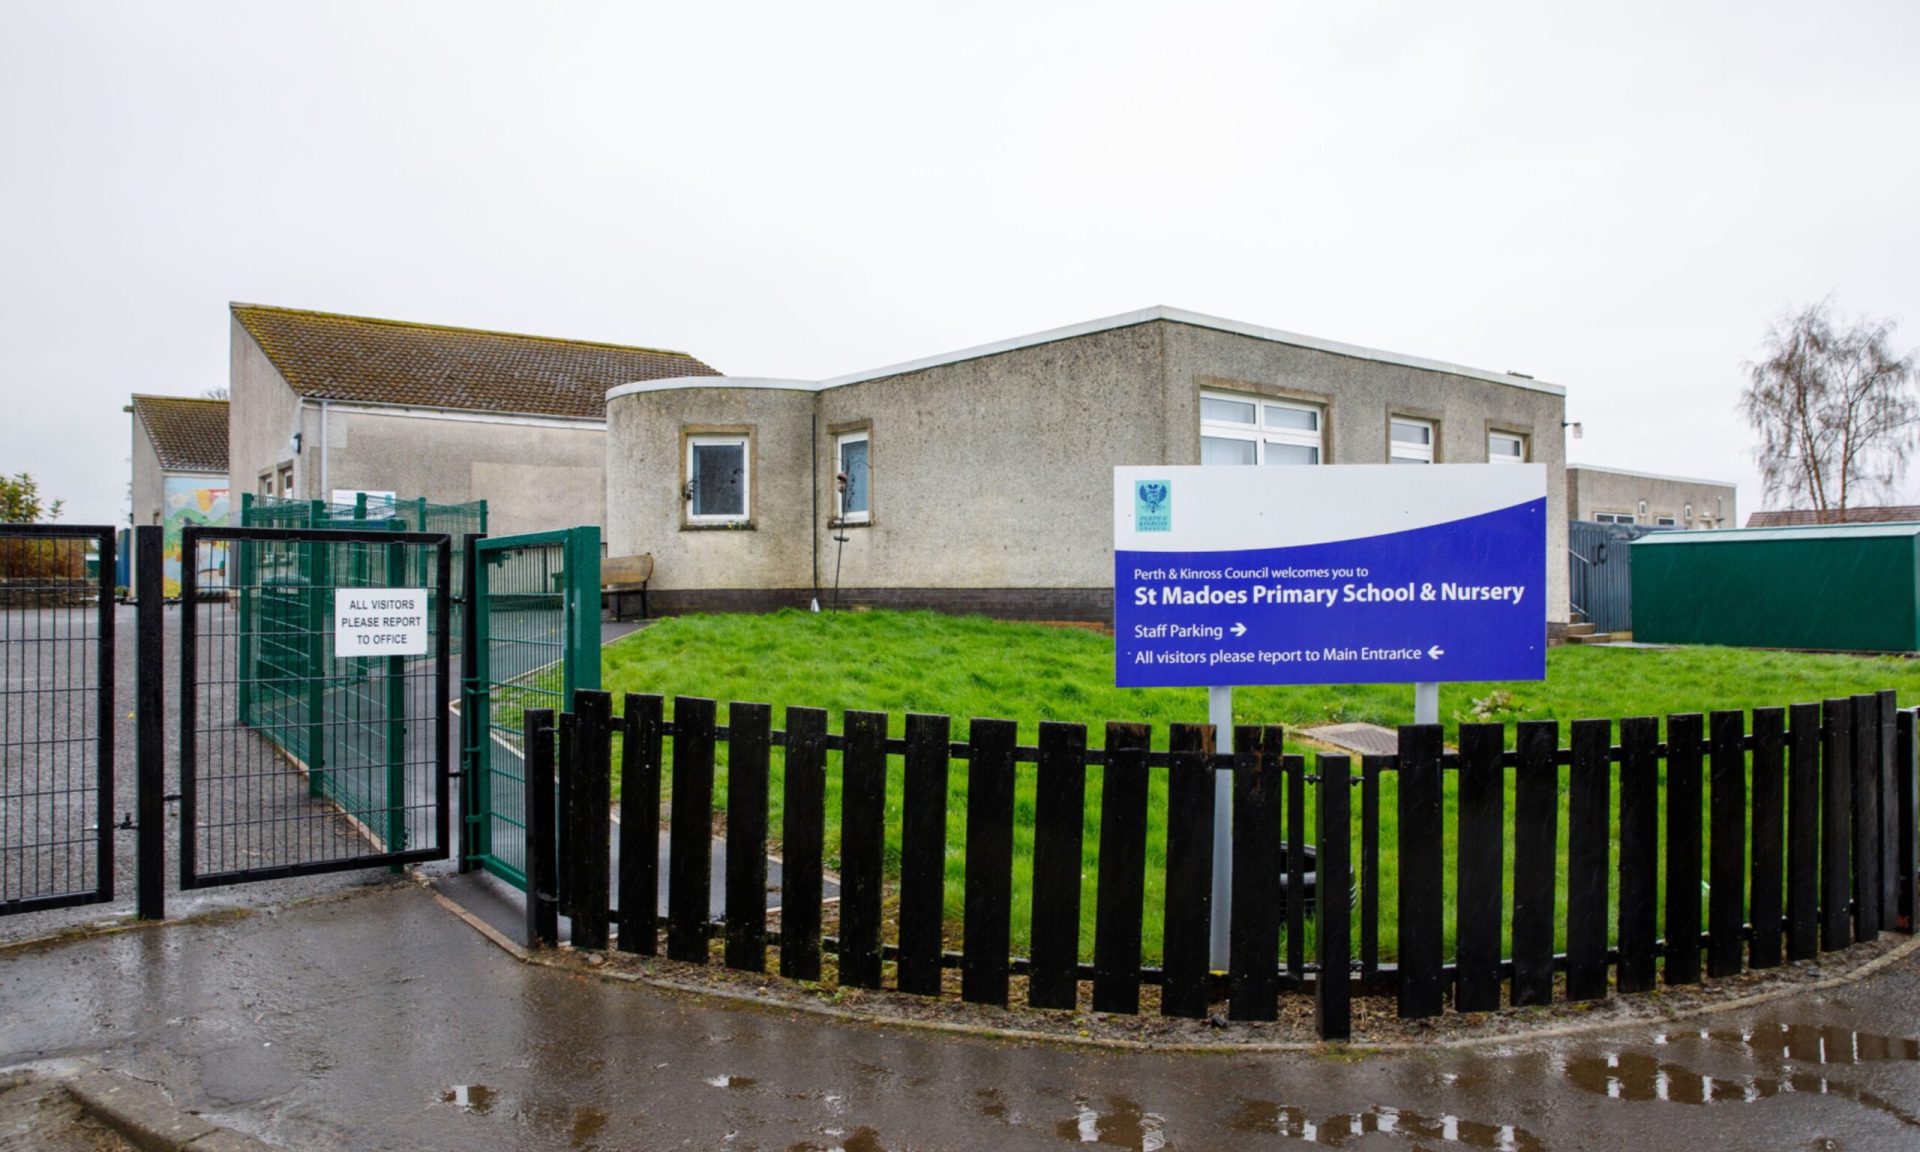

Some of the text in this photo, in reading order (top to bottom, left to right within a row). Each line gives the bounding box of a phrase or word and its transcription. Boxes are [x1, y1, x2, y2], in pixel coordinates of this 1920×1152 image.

[1134, 566, 1369, 580] Perth & Kinross Council welcomes you to
[1134, 582, 1525, 608] St Madoes Primary School & Nursery
[349, 599, 415, 610] ALL VISITORS
[341, 616, 422, 628] PLEASE REPORT
[356, 634, 408, 645] TO OFFICE
[1134, 624, 1223, 641] Staff Parking
[1134, 646, 1422, 666] All visitors please report to Main Entrance
